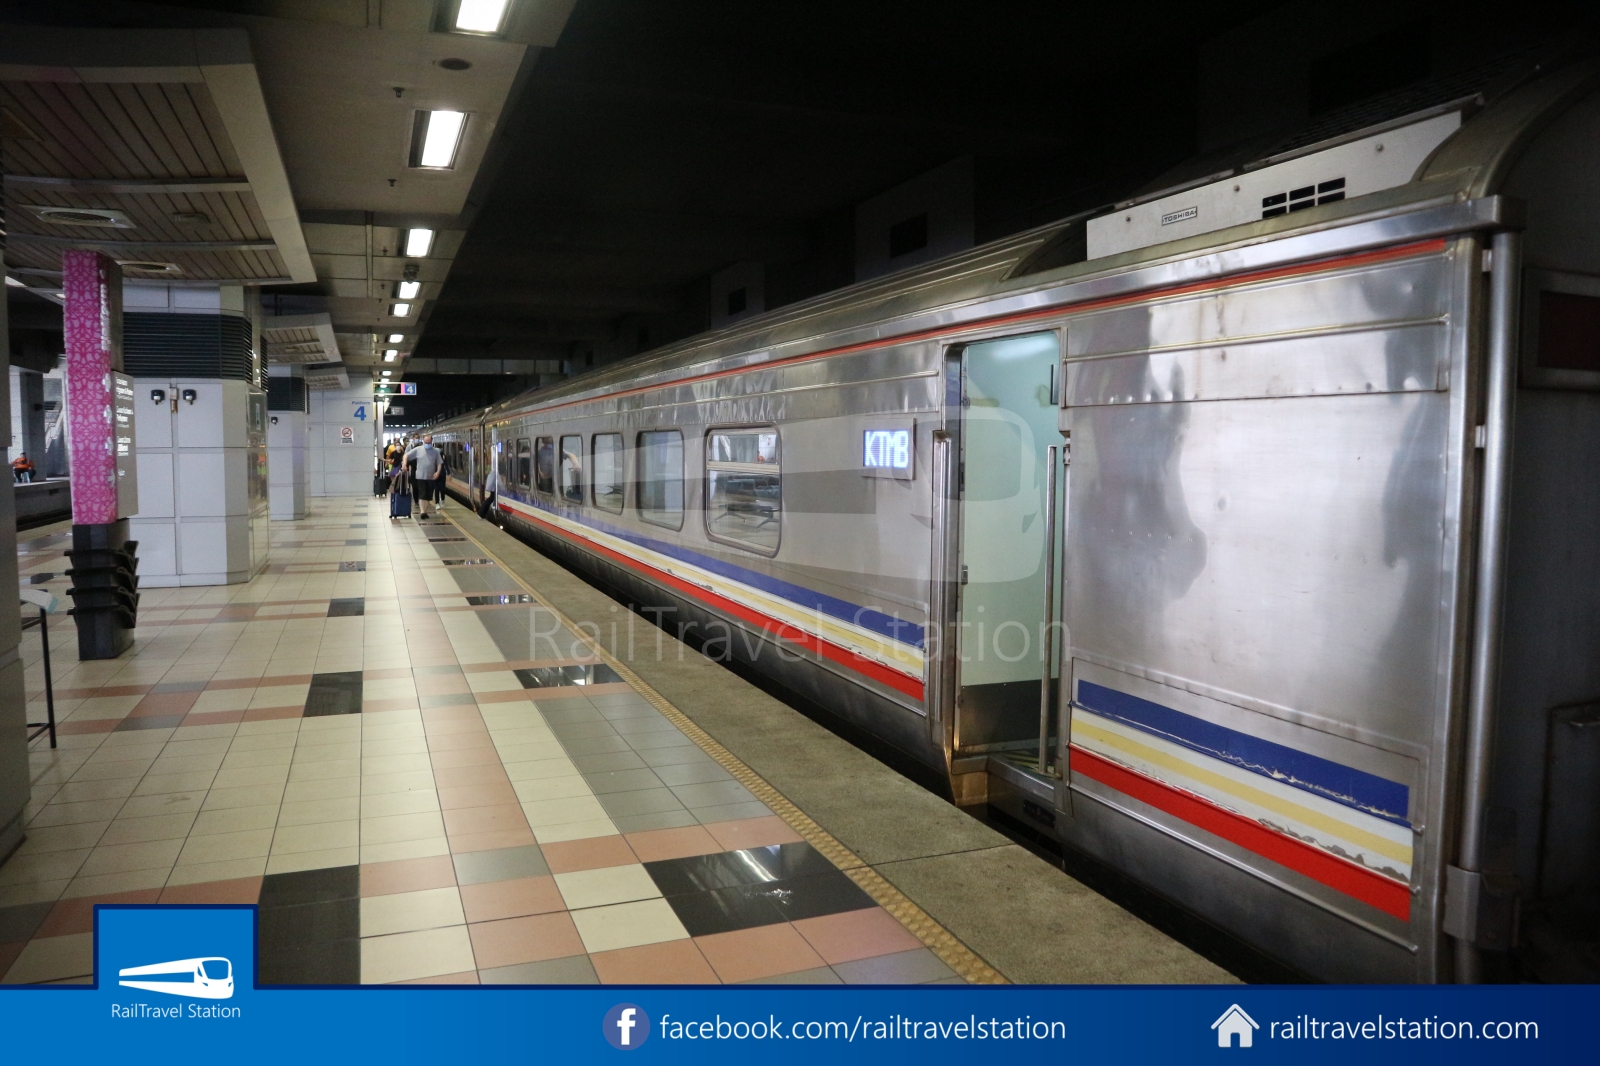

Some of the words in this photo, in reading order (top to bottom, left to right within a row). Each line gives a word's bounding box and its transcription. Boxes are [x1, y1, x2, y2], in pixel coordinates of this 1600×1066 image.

[1163, 209, 1195, 222] TOSHIBA
[406, 385, 414, 394] 4
[353, 405, 367, 421] 4
[864, 430, 909, 468] KTMB
